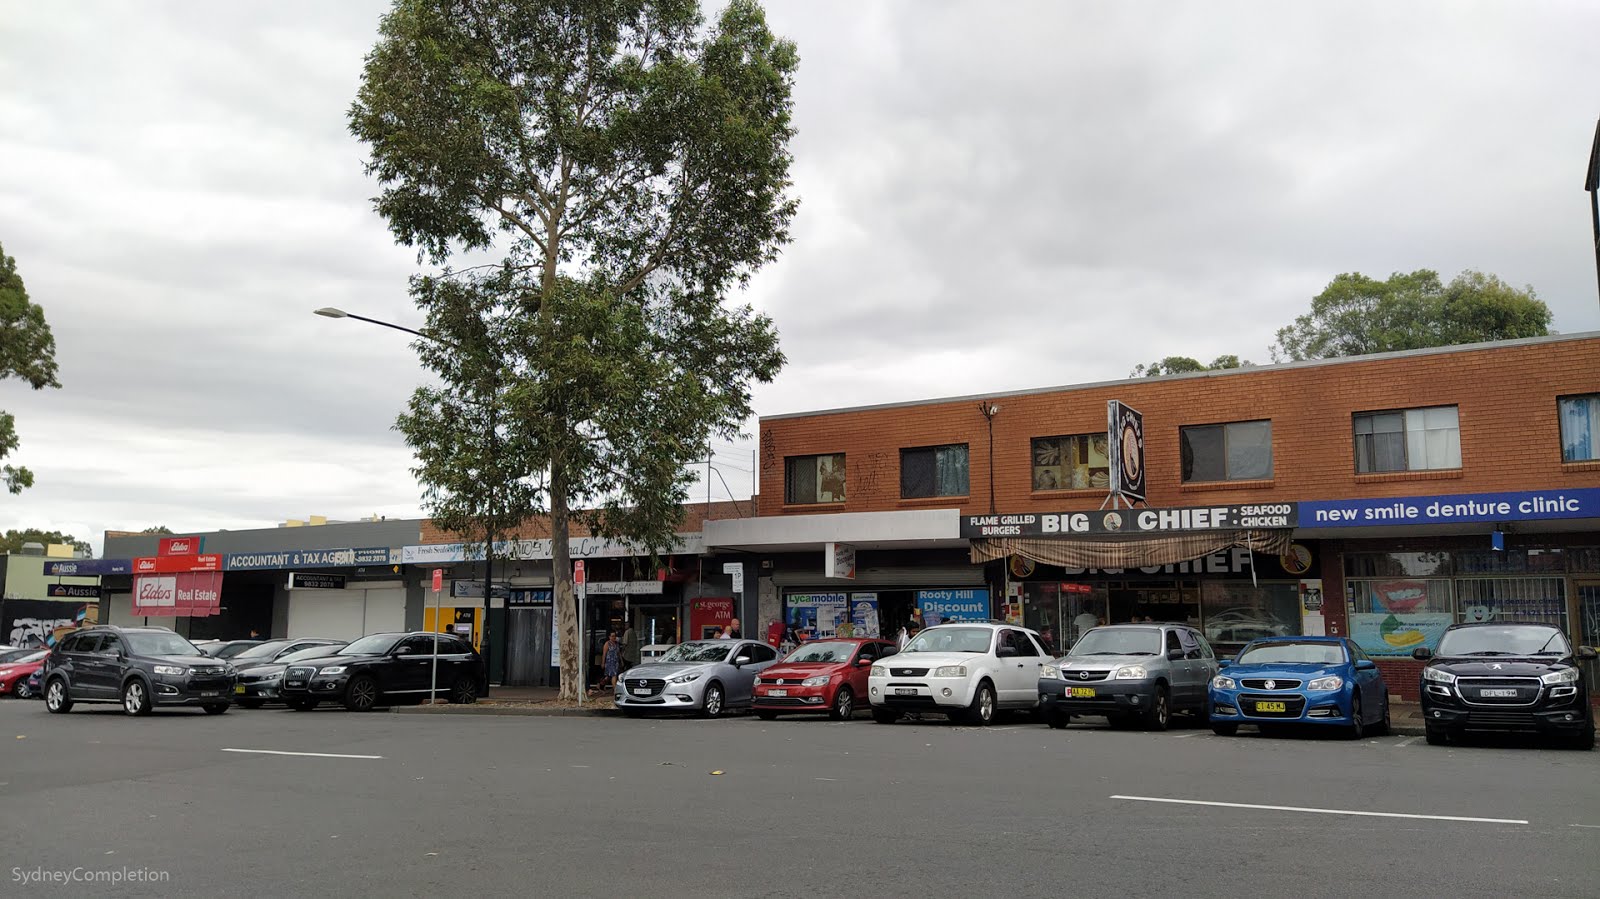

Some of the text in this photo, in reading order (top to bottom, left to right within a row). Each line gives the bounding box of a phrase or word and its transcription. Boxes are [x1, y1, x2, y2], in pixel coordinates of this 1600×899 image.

[1240, 504, 1291, 516] SEAFOOD
[1316, 496, 1580, 522] new smile denture clinic
[970, 514, 1036, 526] FLAME GRILLED
[1041, 507, 1229, 533] BIG CHIEF
[1240, 515, 1288, 527] CHICKEN
[982, 525, 1021, 536] BURGERS
[417, 546, 433, 554] Fresh
[433, 545, 457, 554] Seafood
[579, 538, 601, 557] Lor
[230, 553, 290, 568] ACCOUNTANT
[293, 554, 300, 565] &
[302, 552, 320, 565] TAX
[59, 563, 78, 573] Aussie
[67, 586, 98, 597] Aussie
[140, 583, 173, 600] Elders
[177, 589, 217, 601] Real Estate
[920, 589, 974, 601] Rooty Hill
[788, 593, 845, 604] Lycamobile
[924, 601, 984, 613] Discount
[714, 611, 731, 619] ATM
